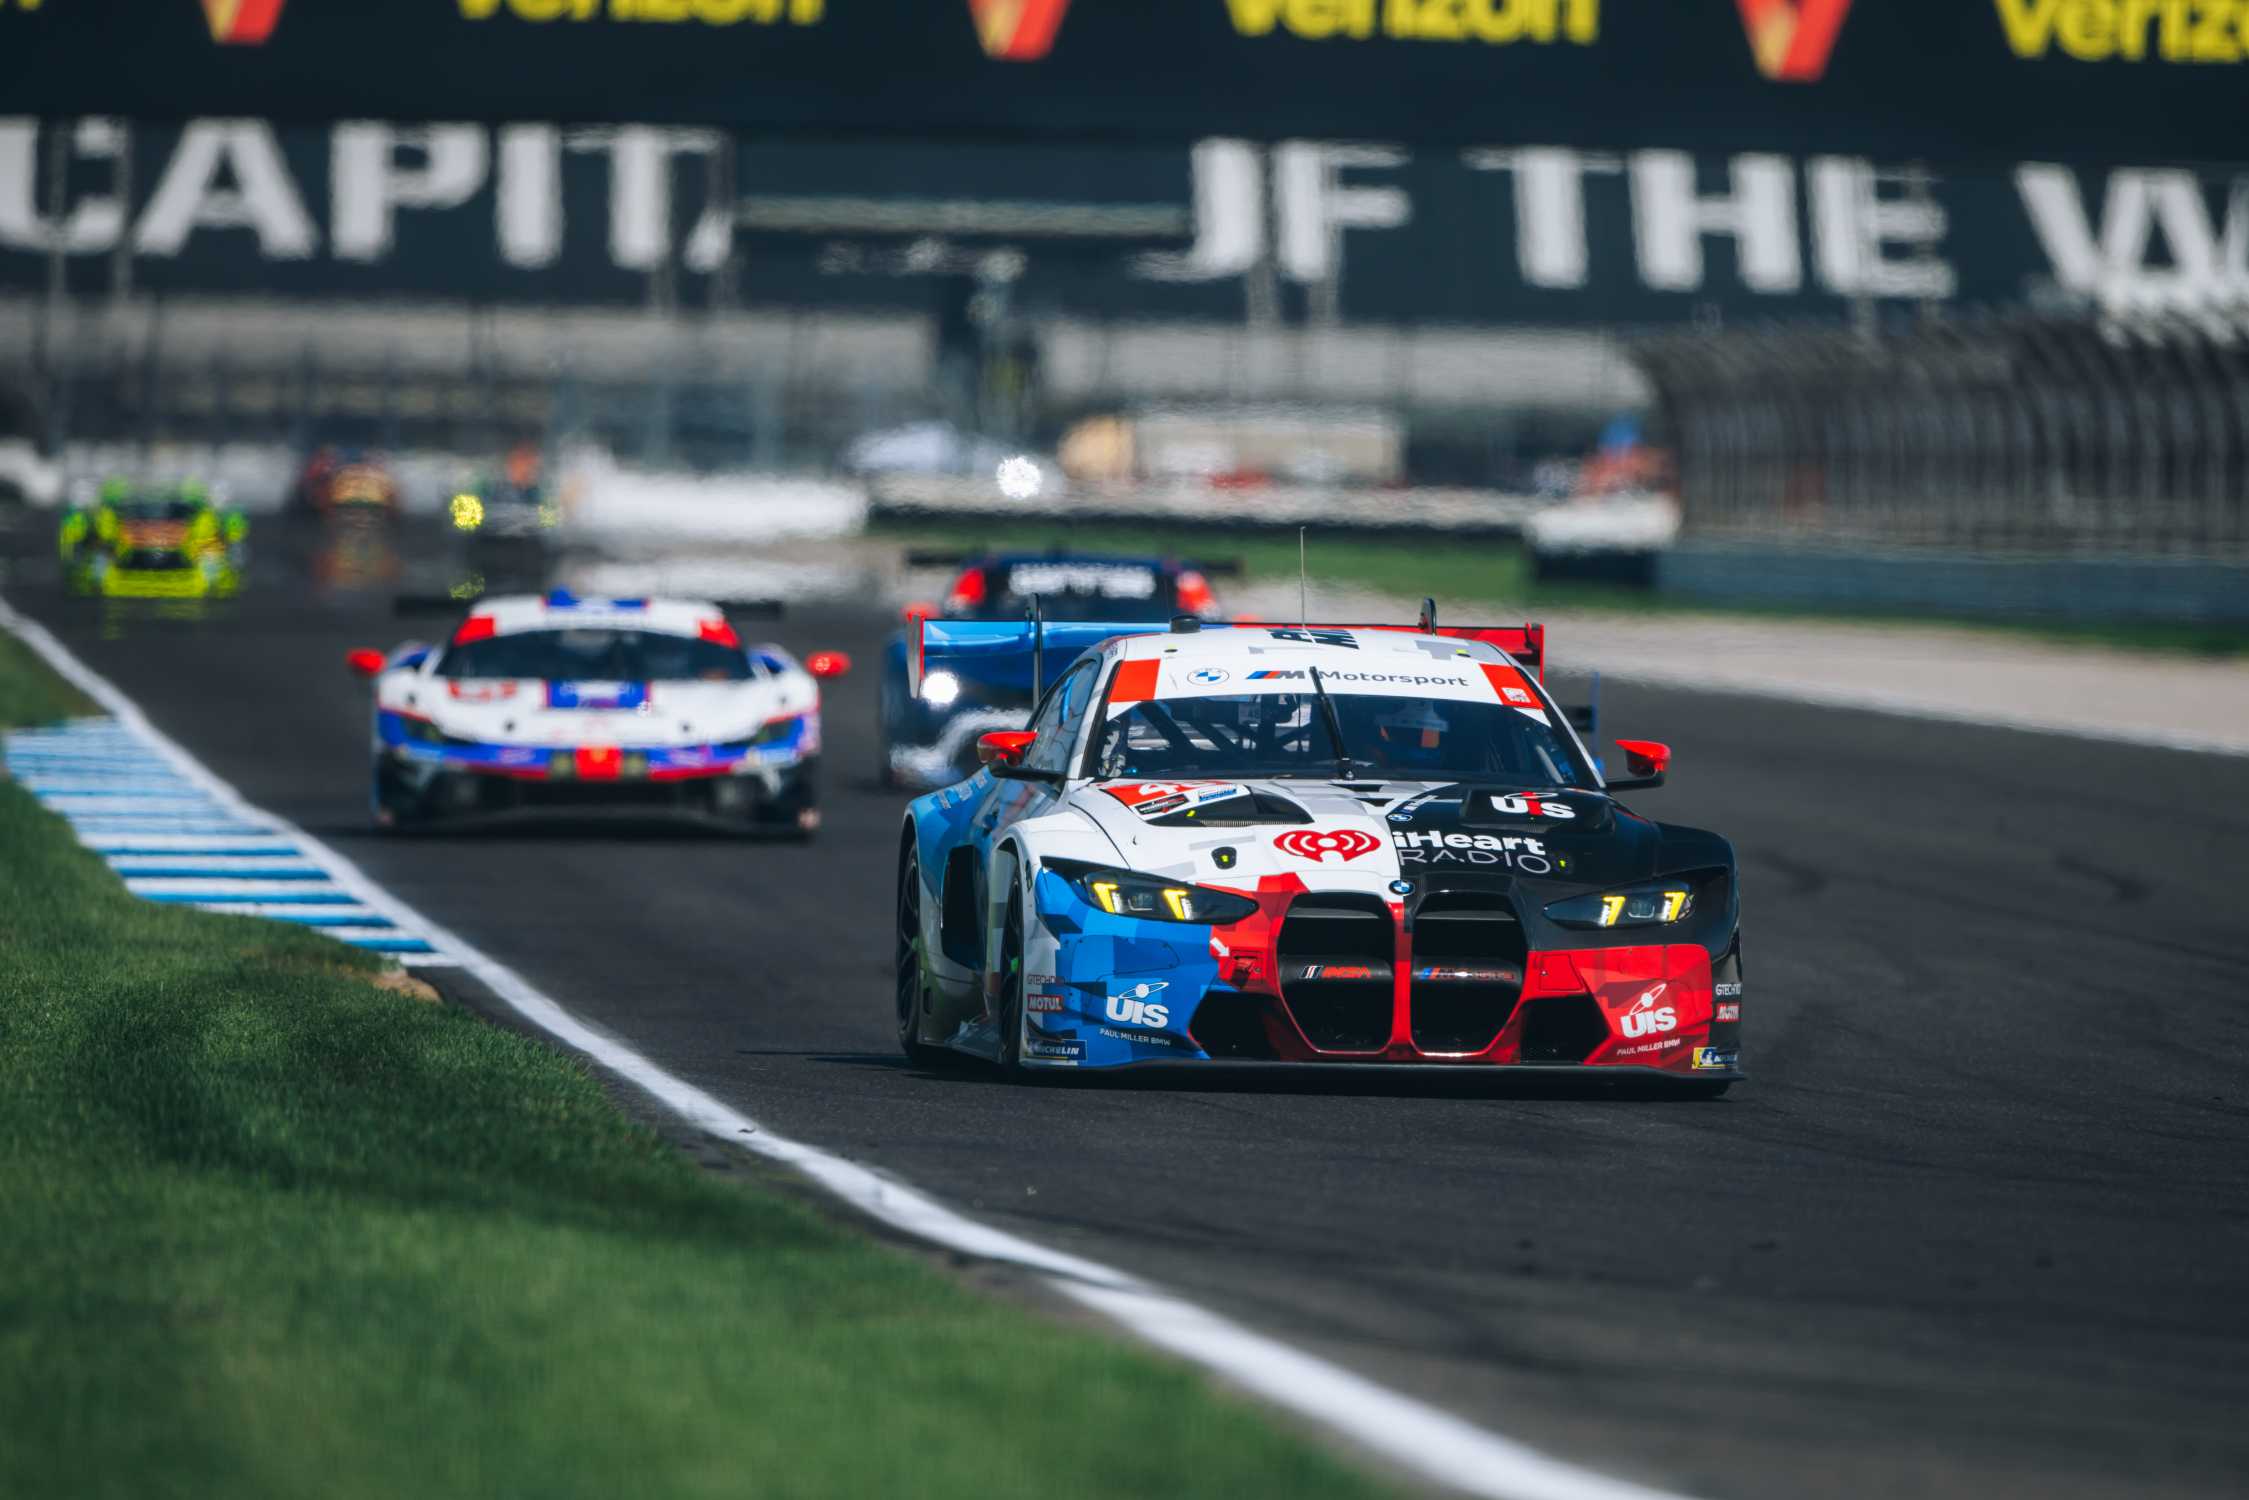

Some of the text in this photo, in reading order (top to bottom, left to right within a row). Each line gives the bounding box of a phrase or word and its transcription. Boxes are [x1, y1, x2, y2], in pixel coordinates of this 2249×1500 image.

[1995, 0, 2249, 63] veriz
[0, 115, 740, 273] CAPIT
[1461, 145, 1958, 300] THE
[1317, 670, 1470, 687] Motorsport
[1392, 830, 1547, 856] iHeart
[1398, 849, 1552, 875] RADIO
[1028, 996, 1062, 1011] MOTUL
[1099, 1028, 1119, 1038] PAUL
[1121, 1032, 1149, 1042] MILLER
